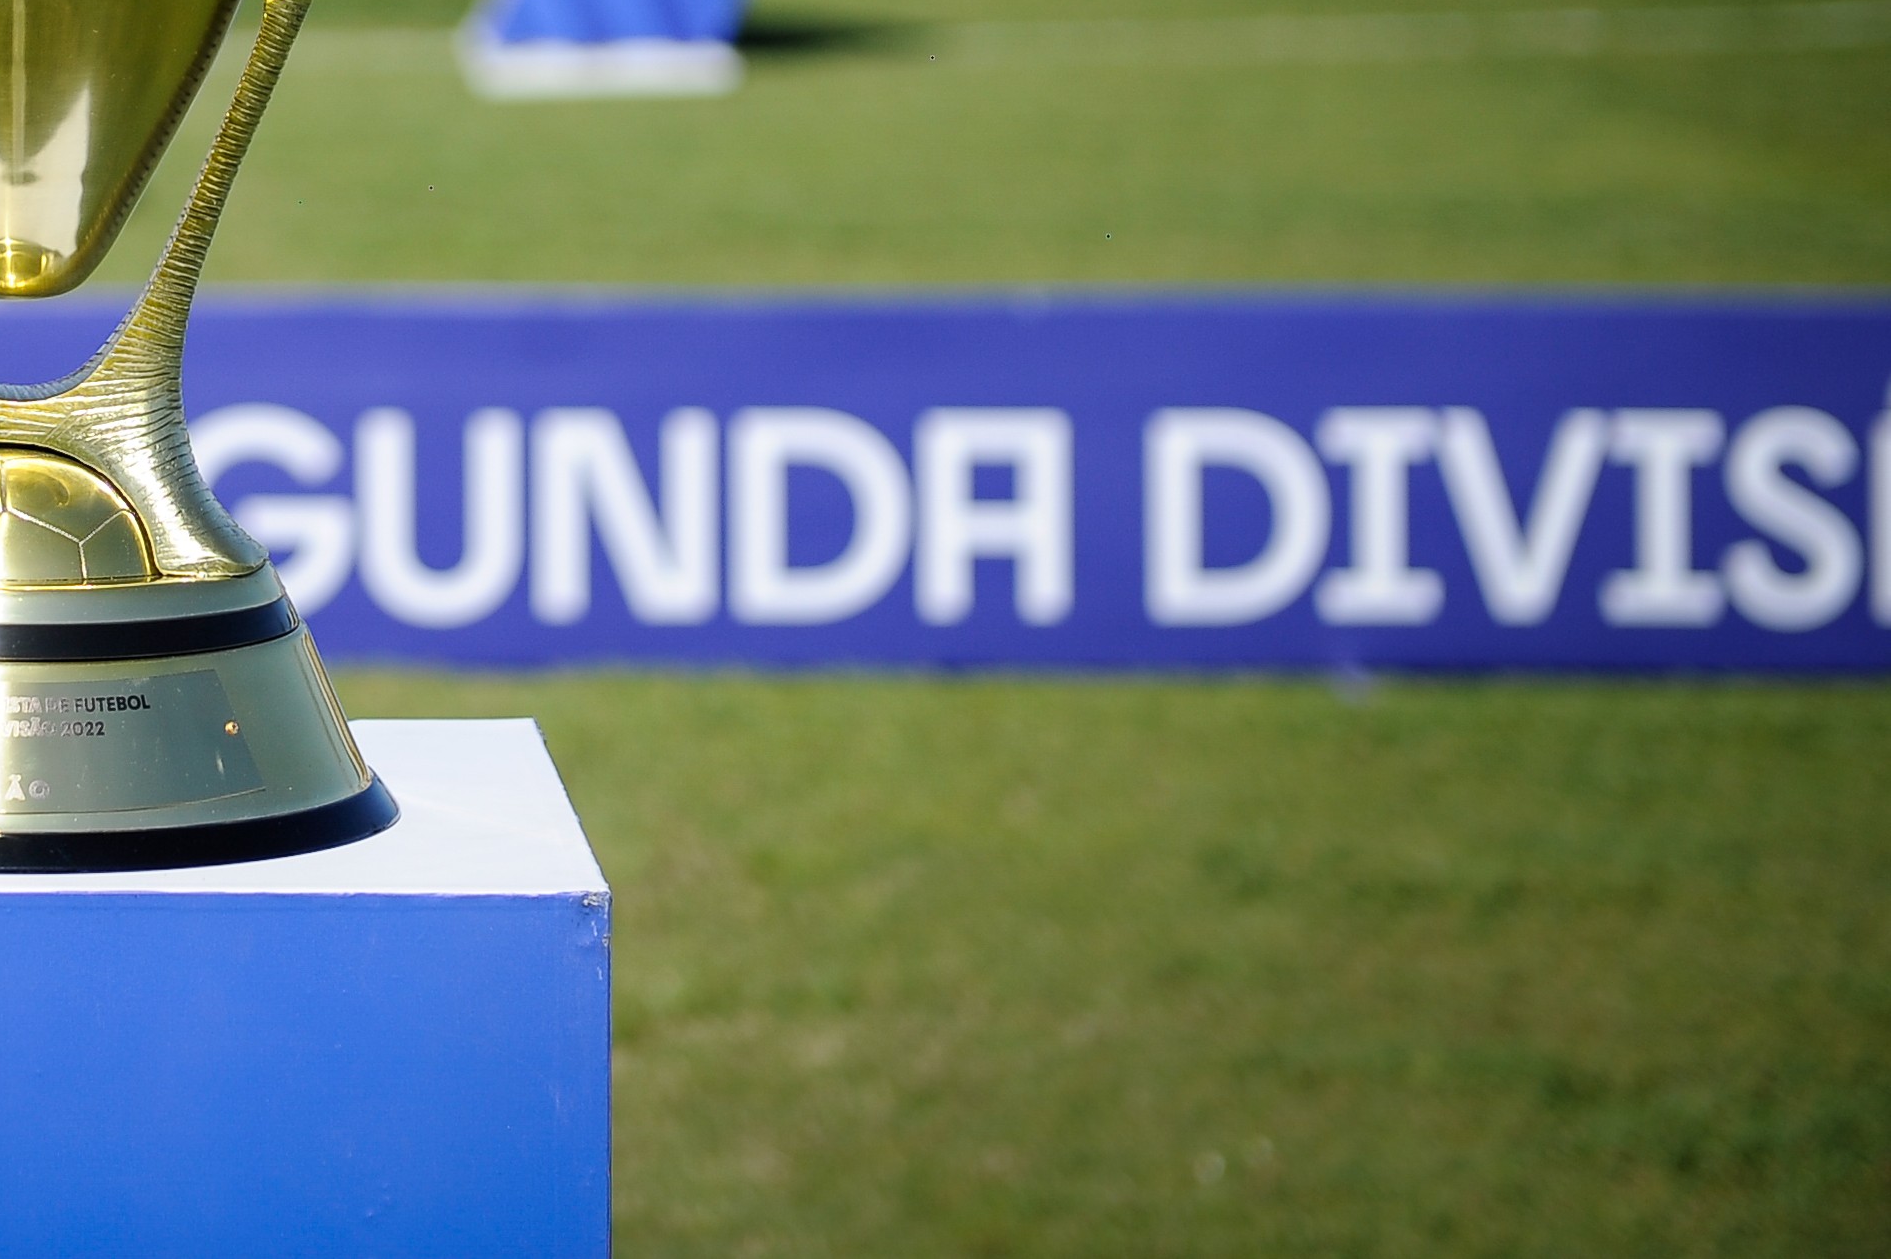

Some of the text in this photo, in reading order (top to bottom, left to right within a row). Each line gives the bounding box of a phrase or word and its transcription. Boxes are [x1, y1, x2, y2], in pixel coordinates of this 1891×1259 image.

[189, 403, 1074, 630] GUNDA
[1143, 402, 1891, 632] DIVIS
[45, 698, 69, 714] DE
[75, 694, 151, 714] FUTEBOL
[60, 721, 105, 737] 2022
